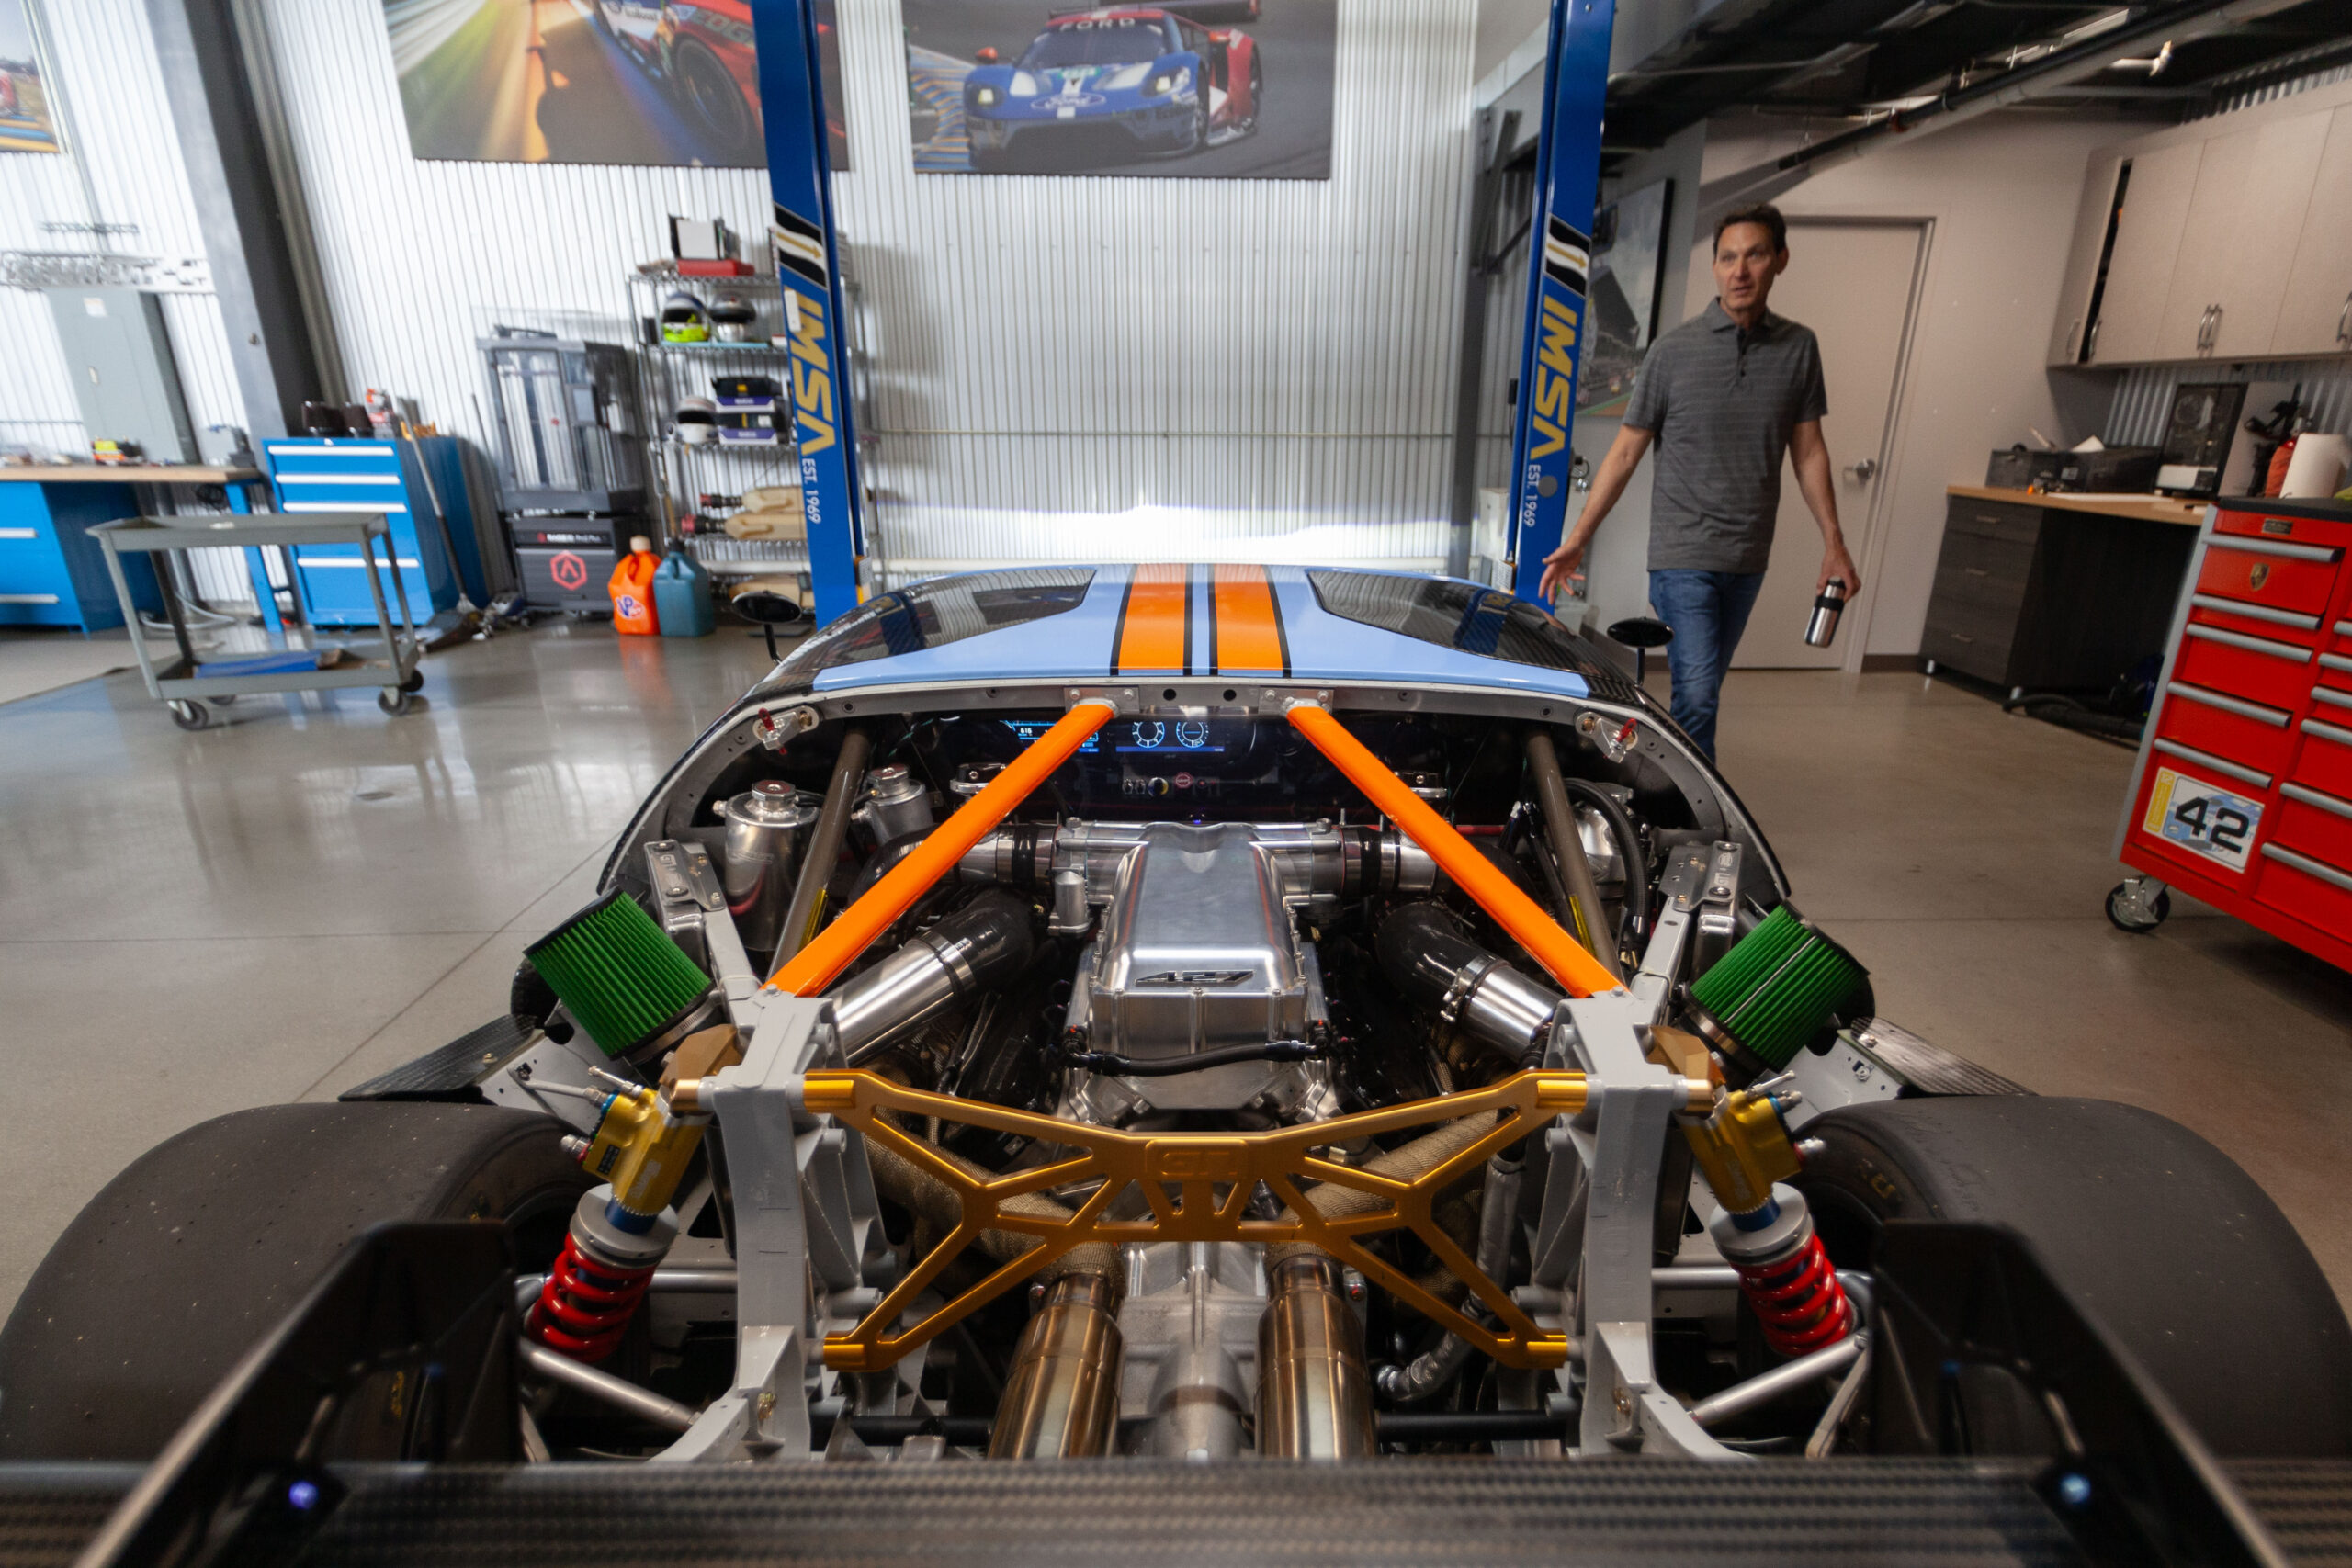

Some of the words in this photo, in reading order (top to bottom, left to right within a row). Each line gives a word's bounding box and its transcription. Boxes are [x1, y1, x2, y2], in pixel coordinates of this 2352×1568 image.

[1059, 17, 1136, 33] FORD
[784, 286, 836, 456] IMSA
[1530, 294, 1577, 460] IMSA
[802, 458, 817, 485] EST.
[805, 490, 822, 525] 1969
[1523, 494, 1538, 528] 1969
[2174, 796, 2250, 854] 42
[1135, 969, 1254, 987] 427
